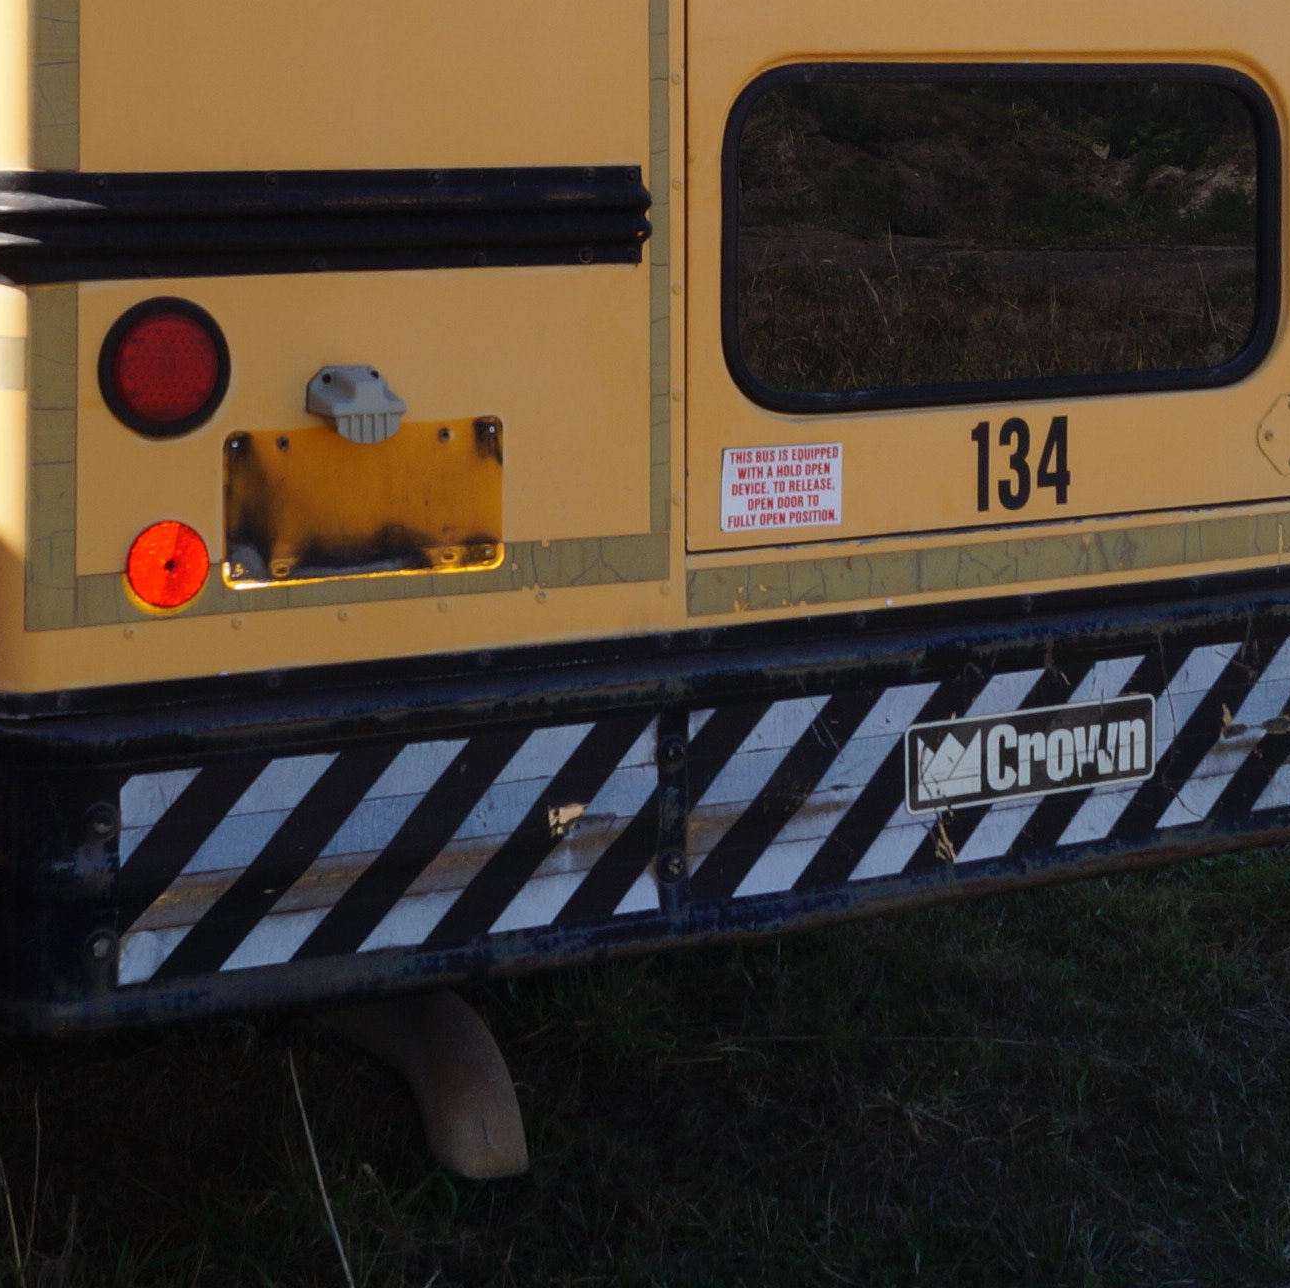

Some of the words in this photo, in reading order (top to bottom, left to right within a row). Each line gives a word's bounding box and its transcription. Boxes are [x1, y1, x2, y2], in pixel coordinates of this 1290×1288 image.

[730, 452, 753, 464] THIS
[756, 450, 775, 463] BUS
[778, 449, 788, 462] IS
[792, 446, 839, 462] EQUIPPED
[971, 415, 1071, 511] 134
[738, 466, 763, 480] WITH
[767, 466, 773, 478] A
[777, 464, 802, 477] HOLD
[805, 462, 830, 476] OPEN
[773, 480, 785, 493] TO
[748, 497, 774, 511] OPEN
[777, 495, 803, 509] DOOR
[807, 494, 819, 507] TO
[728, 514, 756, 528] FULLY
[759, 512, 785, 526] OPEN
[789, 509, 837, 524] POSITION.
[985, 714, 1147, 791] Crown
